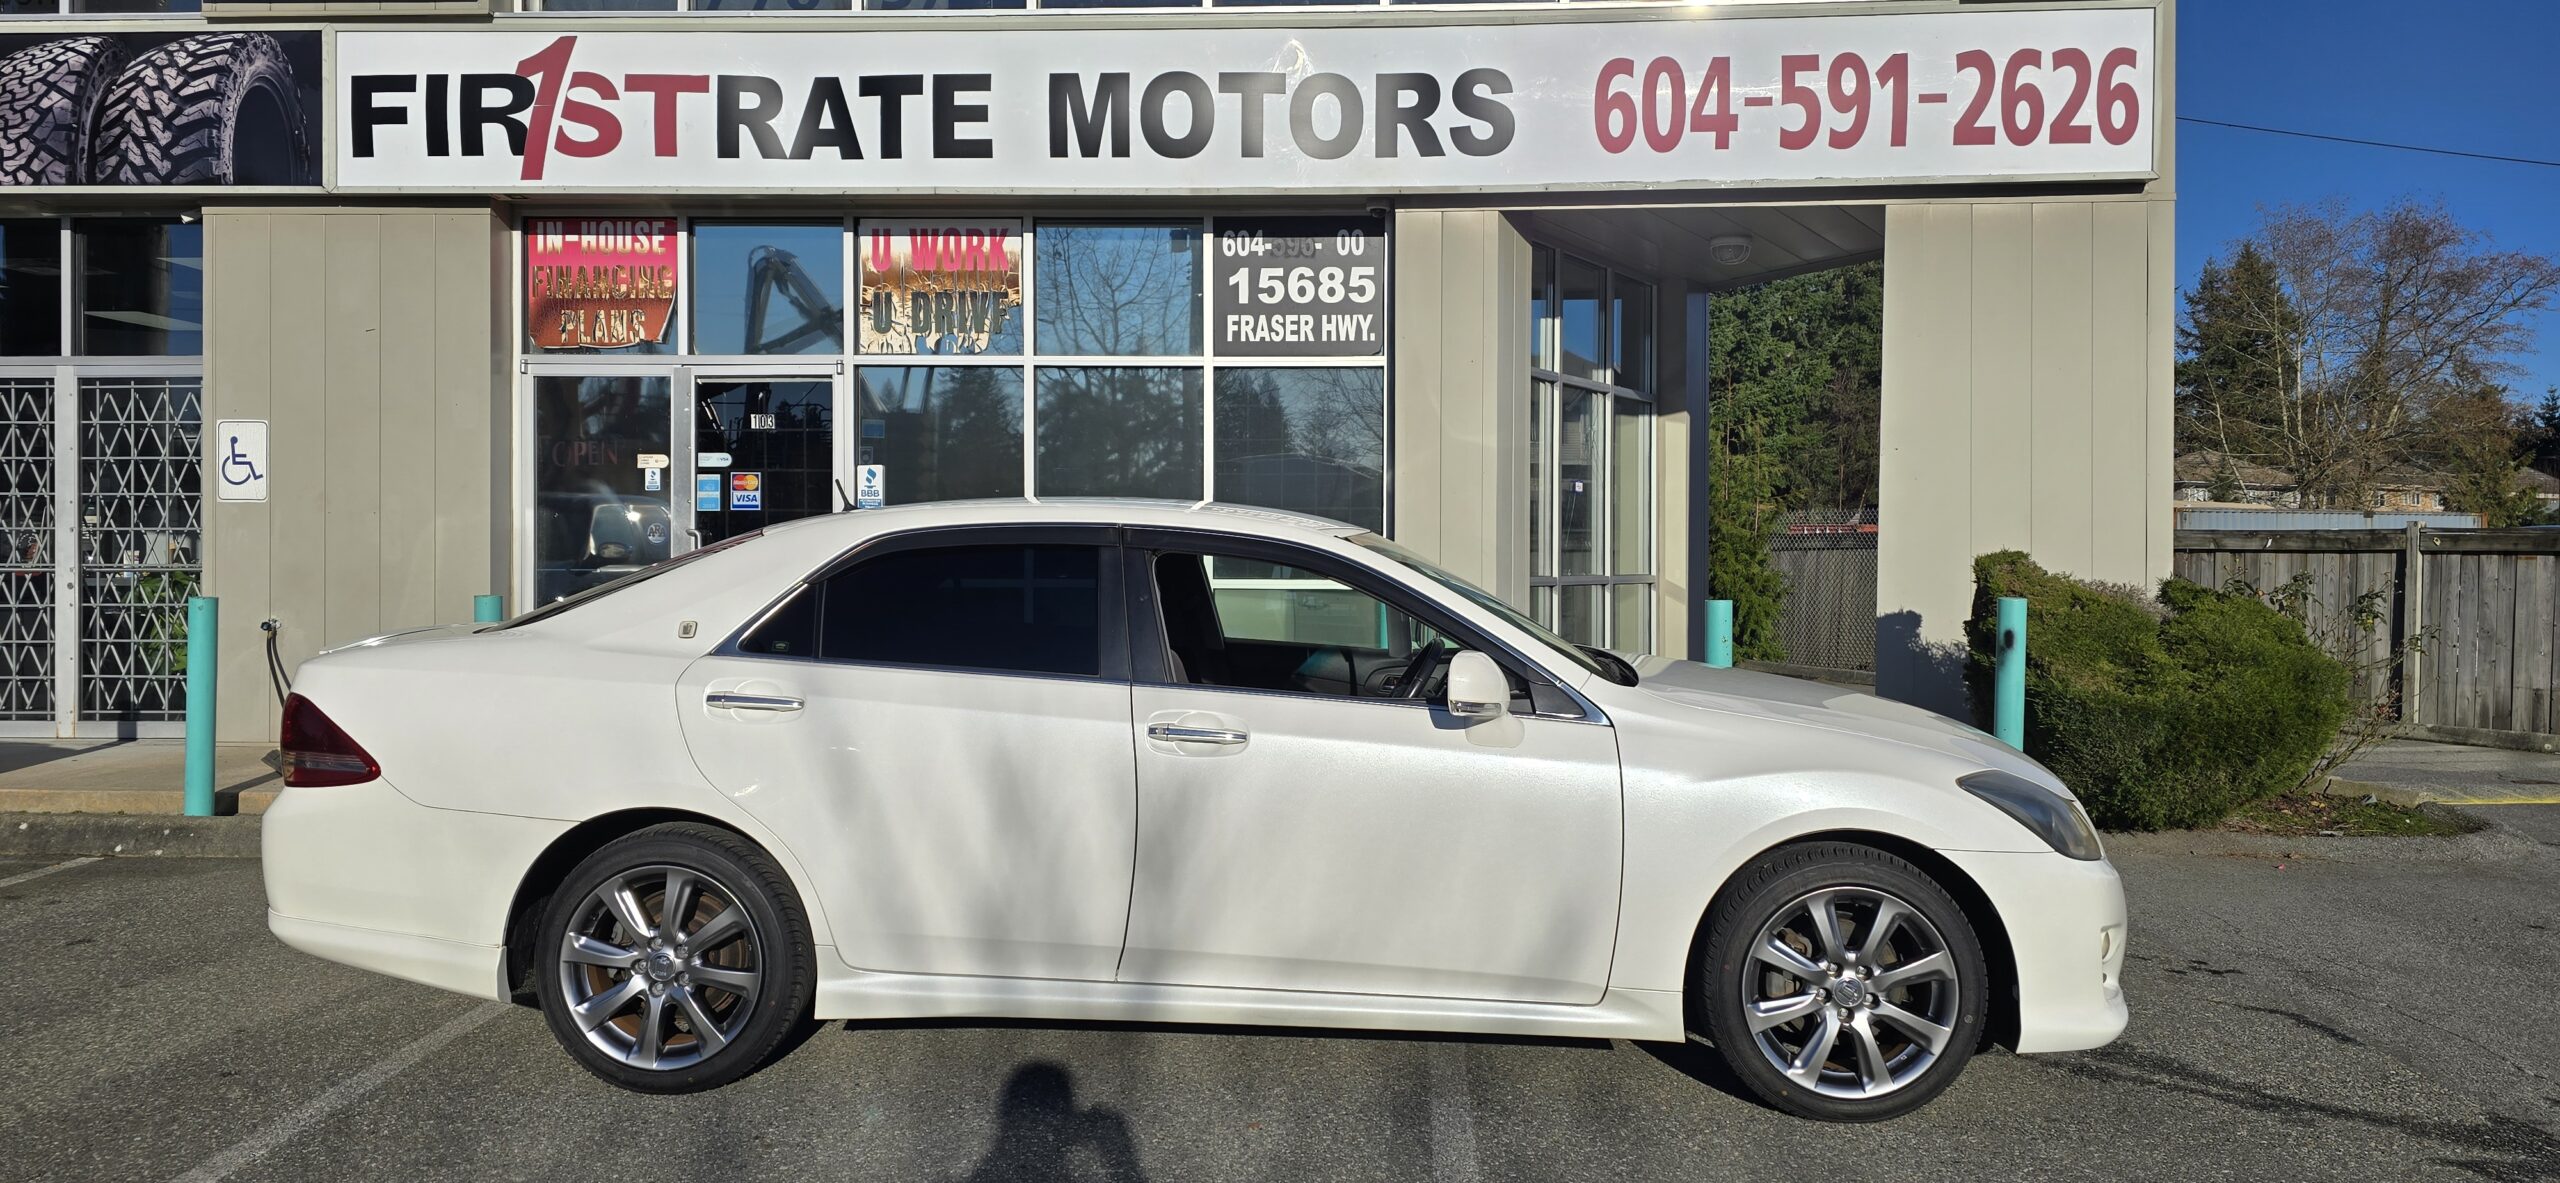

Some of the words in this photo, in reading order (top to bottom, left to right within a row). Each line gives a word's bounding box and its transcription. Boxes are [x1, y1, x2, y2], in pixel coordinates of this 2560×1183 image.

[1049, 67, 1516, 160] MOTORS
[1594, 47, 2140, 154] 604-591-2626
[536, 220, 666, 255] IN-HOUSE
[871, 228, 892, 272] U
[909, 227, 1010, 272] WORK
[533, 264, 673, 300] FINANCING
[1228, 266, 1376, 304] 15685
[560, 308, 645, 344] PLANS
[872, 291, 893, 335] U
[1226, 313, 1315, 342] FRASER
[1321, 313, 1376, 342] HWY.
[752, 414, 774, 429] 103
[735, 494, 758, 503] VISA
[860, 489, 880, 498] BBB
